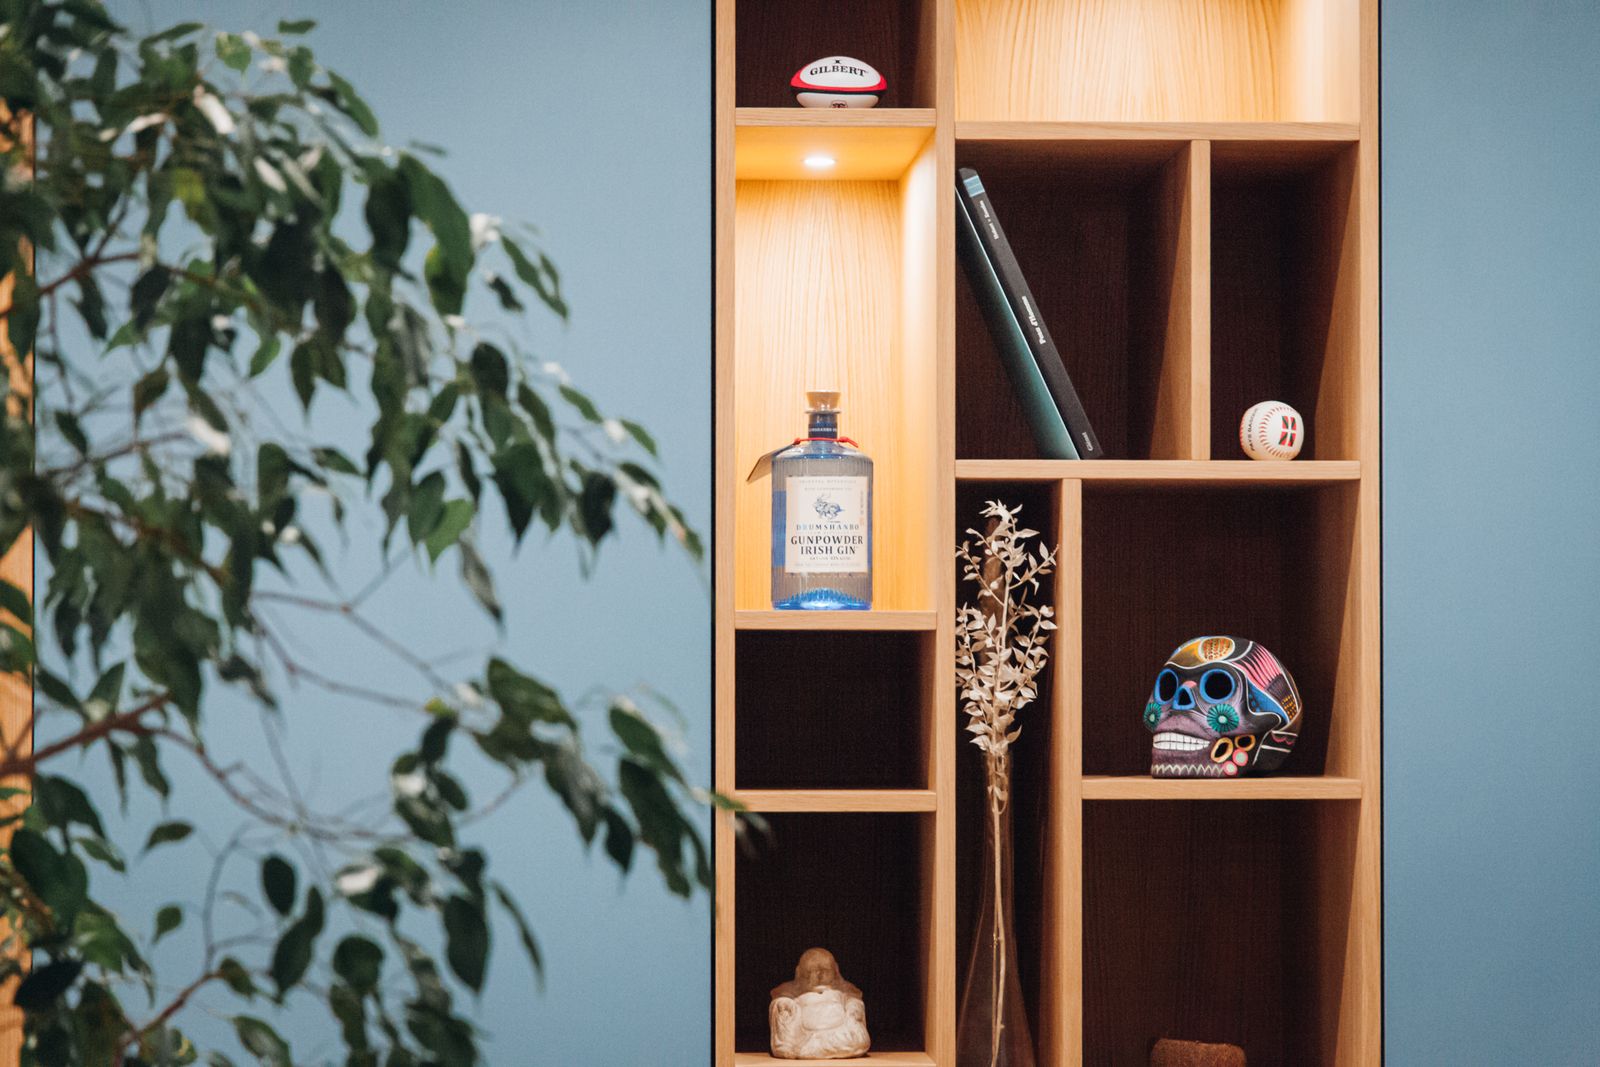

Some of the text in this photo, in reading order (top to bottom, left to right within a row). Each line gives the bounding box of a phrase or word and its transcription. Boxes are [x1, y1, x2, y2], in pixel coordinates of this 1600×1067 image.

[809, 65, 866, 77] GILBERT
[790, 535, 864, 545] GUNPOWDER
[800, 545, 856, 555] IRISH GIN
